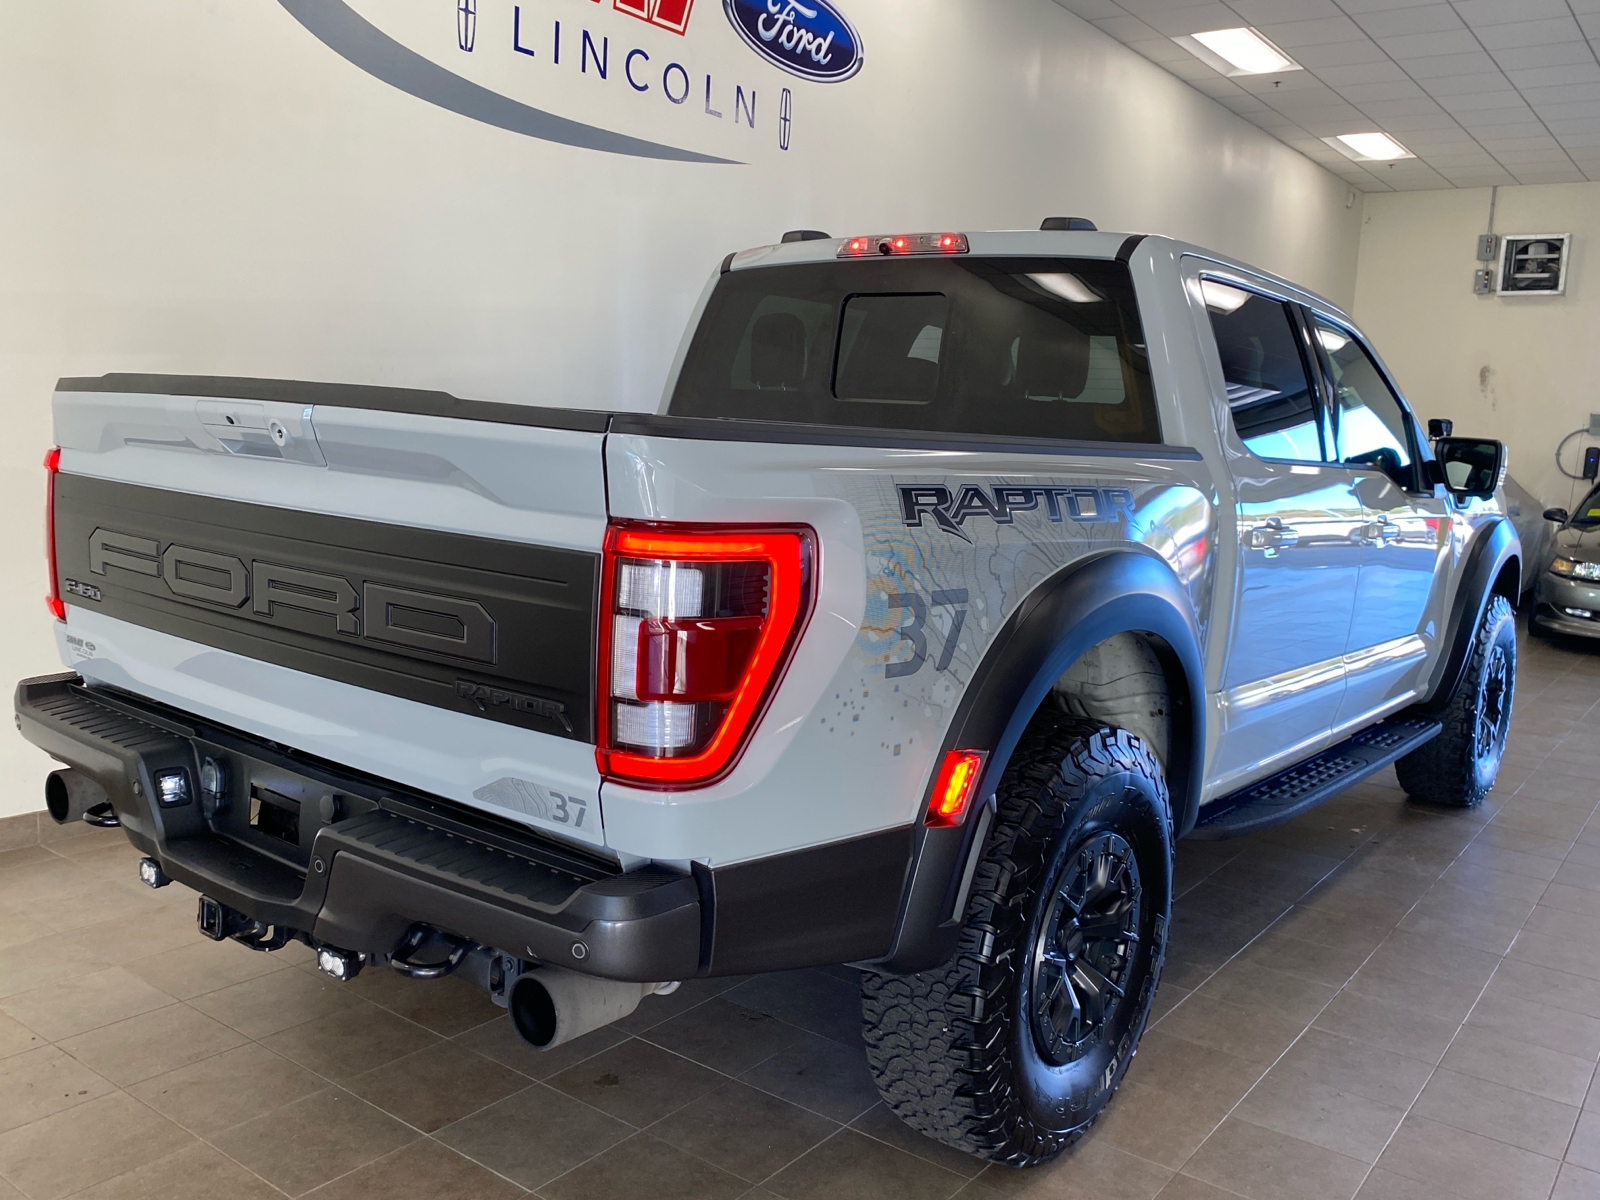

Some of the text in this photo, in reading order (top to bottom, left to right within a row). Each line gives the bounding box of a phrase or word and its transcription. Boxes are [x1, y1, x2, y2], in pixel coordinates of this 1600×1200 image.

[757, 0, 835, 66] Ford
[512, 5, 757, 129] LINCOLN
[896, 483, 1145, 545] RAPTOR
[88, 526, 497, 667] FORD
[885, 588, 969, 679] 37
[454, 677, 574, 733] RAPTOR
[548, 790, 588, 829] 37
